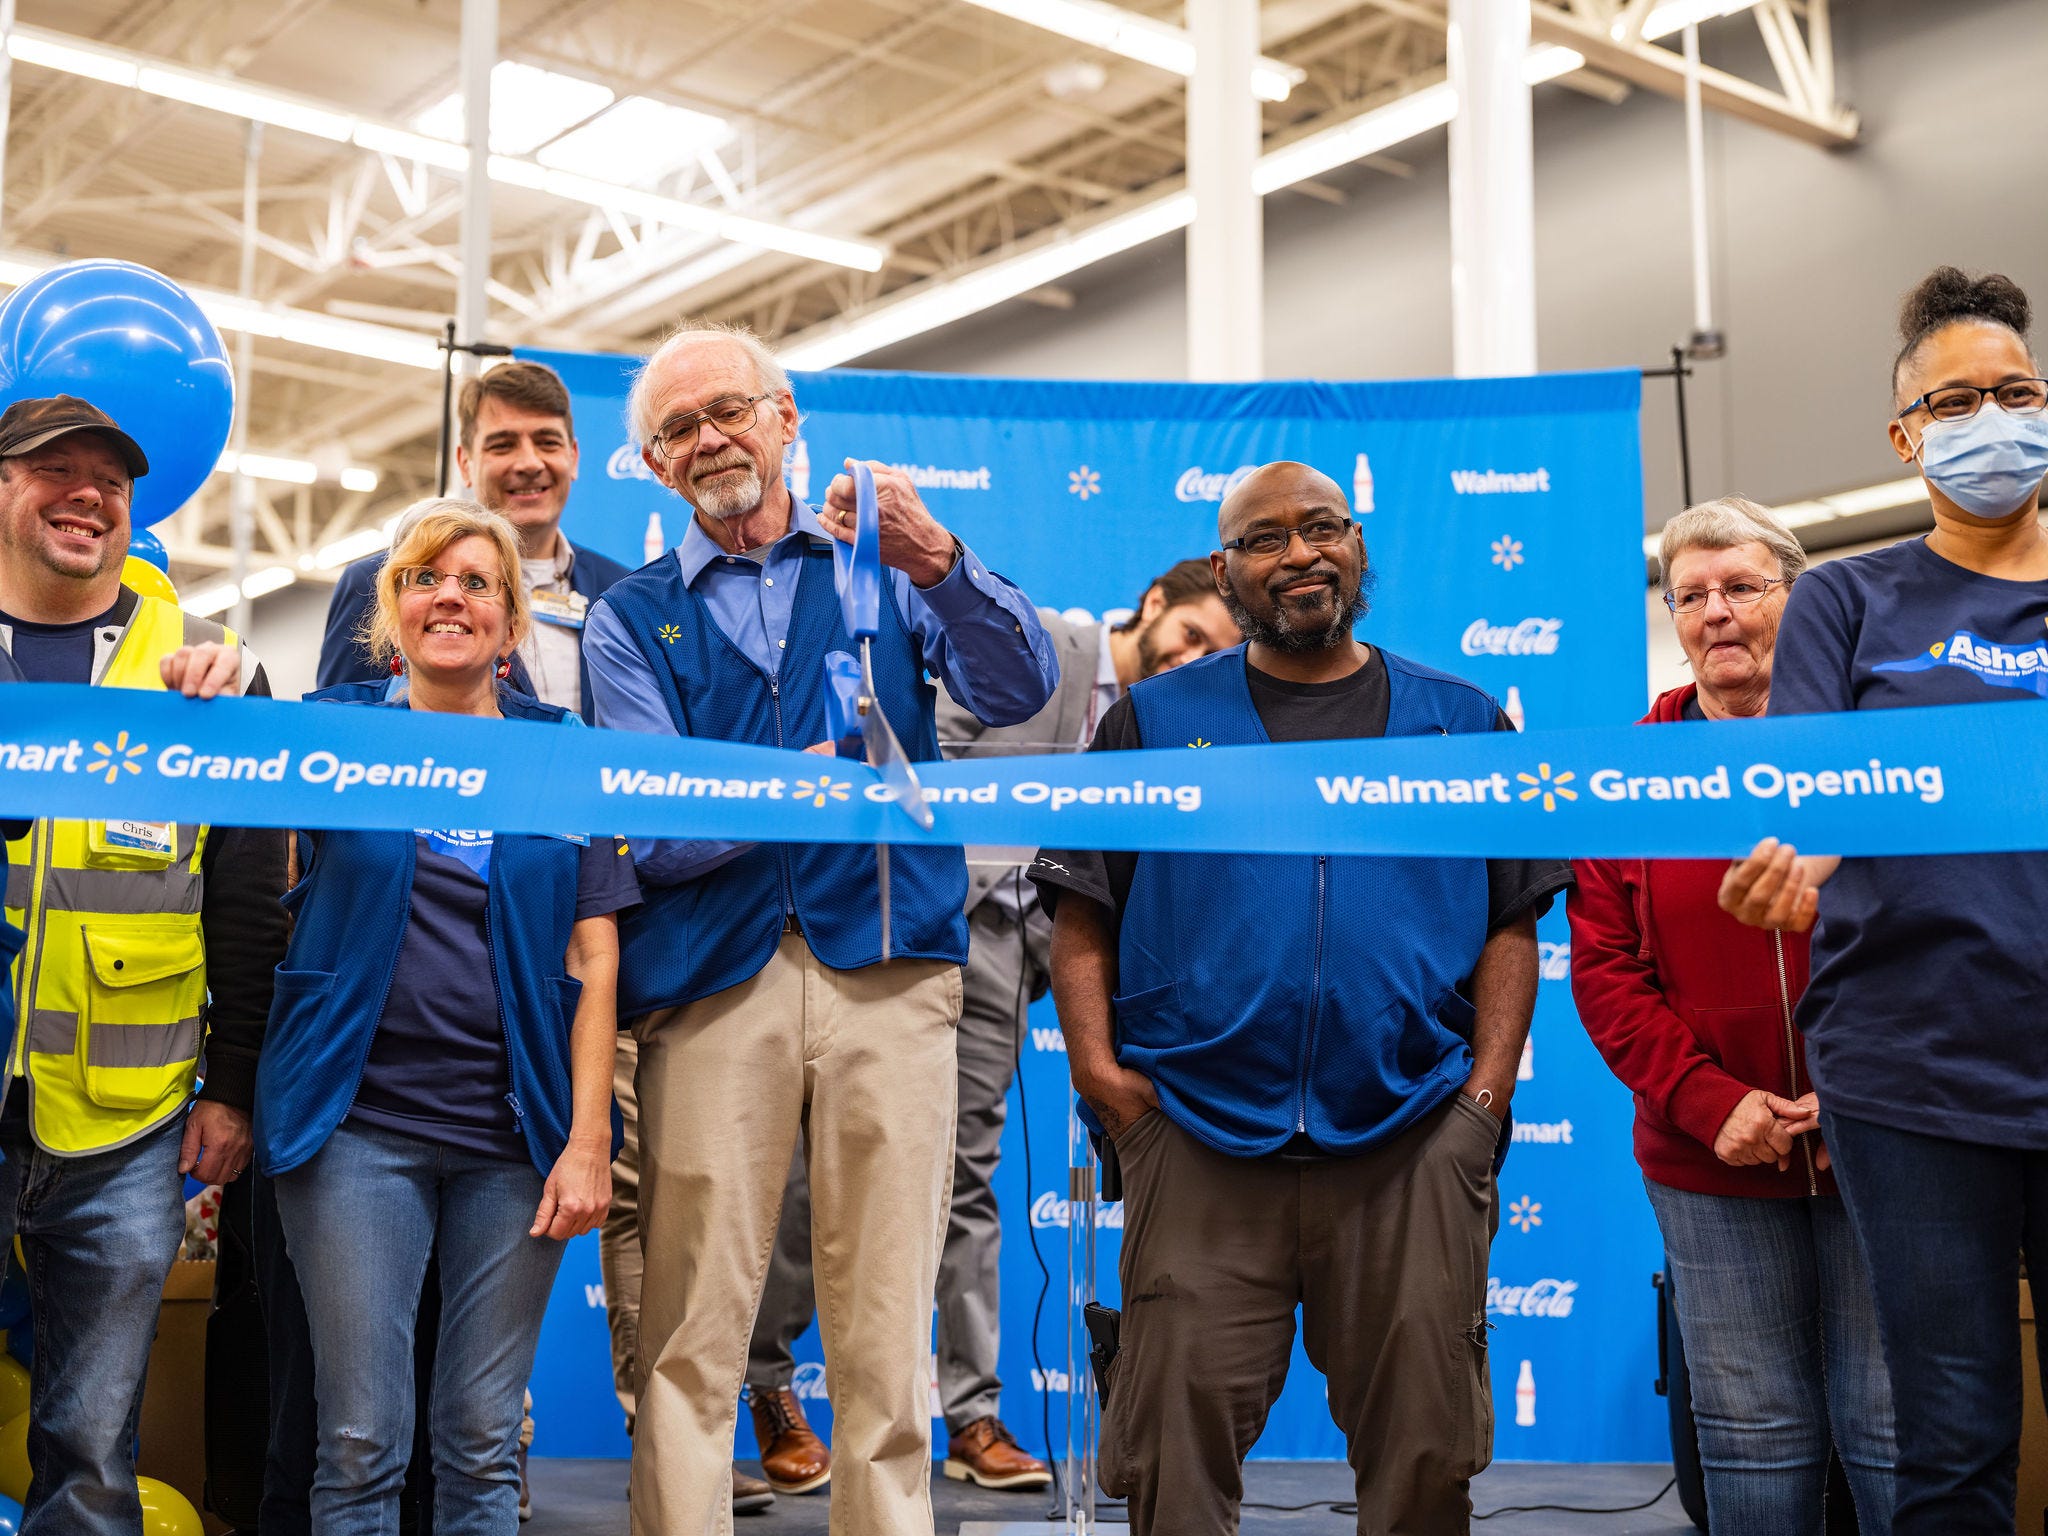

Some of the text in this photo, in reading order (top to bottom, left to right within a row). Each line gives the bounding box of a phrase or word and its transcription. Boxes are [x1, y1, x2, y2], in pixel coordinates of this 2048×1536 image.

[1450, 467, 1550, 494] Walmart
[157, 744, 290, 781] Grand
[299, 751, 487, 797] Opening
[1315, 759, 1944, 808] Walmart Grand Opening
[600, 767, 1202, 812] Walmart Gand Opening
[122, 821, 153, 838] Chris
[1511, 1118, 1574, 1144] lmart
